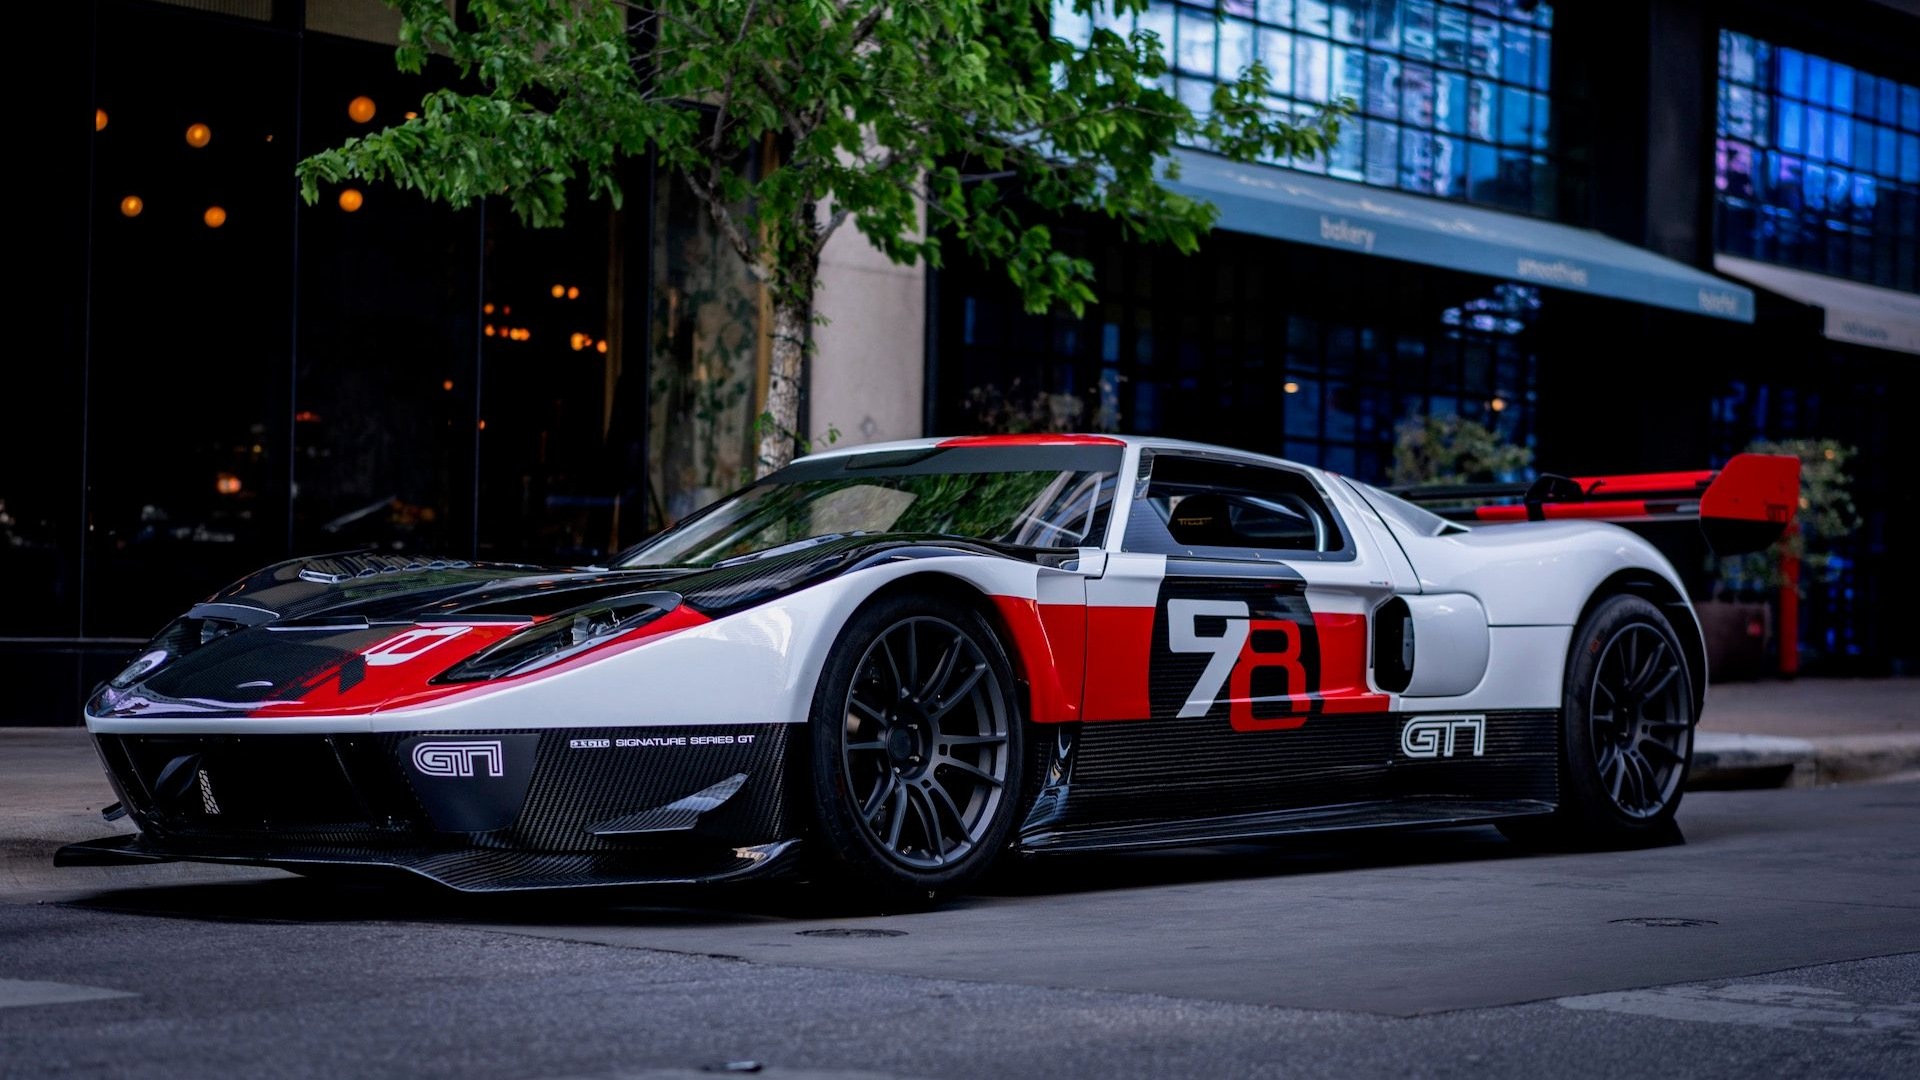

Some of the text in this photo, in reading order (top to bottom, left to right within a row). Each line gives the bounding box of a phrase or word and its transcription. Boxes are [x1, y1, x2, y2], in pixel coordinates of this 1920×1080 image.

[1320, 214, 1376, 251] bakery
[1167, 598, 1312, 732] 98
[615, 737, 686, 748] SIGNATURE
[690, 735, 735, 745] SERIES
[737, 734, 755, 744] GT
